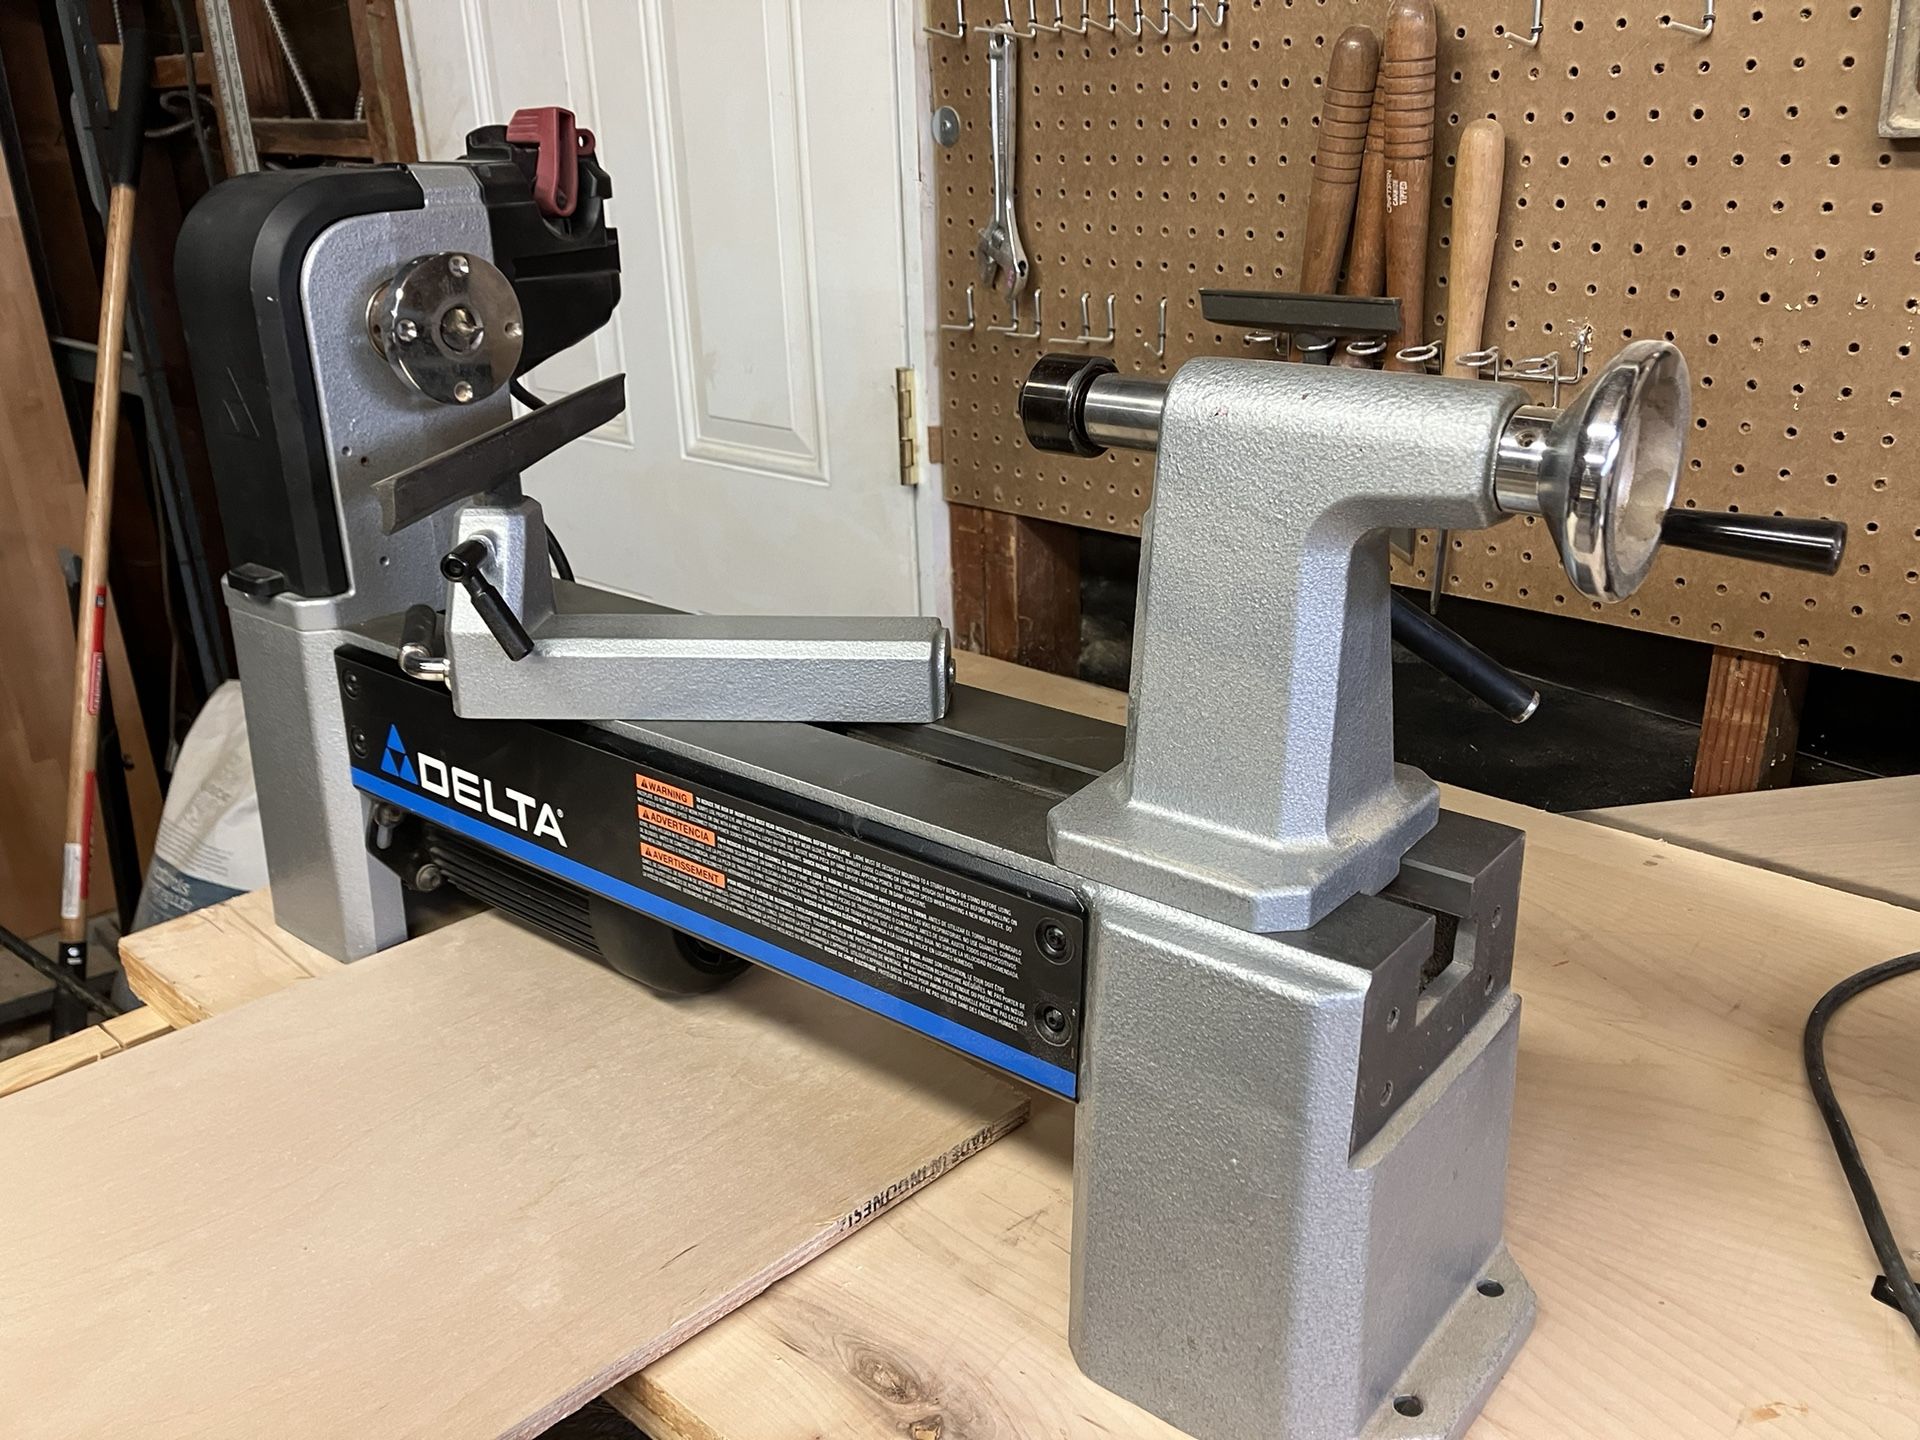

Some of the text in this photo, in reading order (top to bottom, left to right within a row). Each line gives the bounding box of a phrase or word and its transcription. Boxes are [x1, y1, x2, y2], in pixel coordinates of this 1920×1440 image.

[417, 752, 568, 848] DELTA
[649, 781, 687, 803] WARNING
[651, 813, 710, 842] ADVERTENCIA
[653, 850, 719, 881] AVERTISSEMENT
